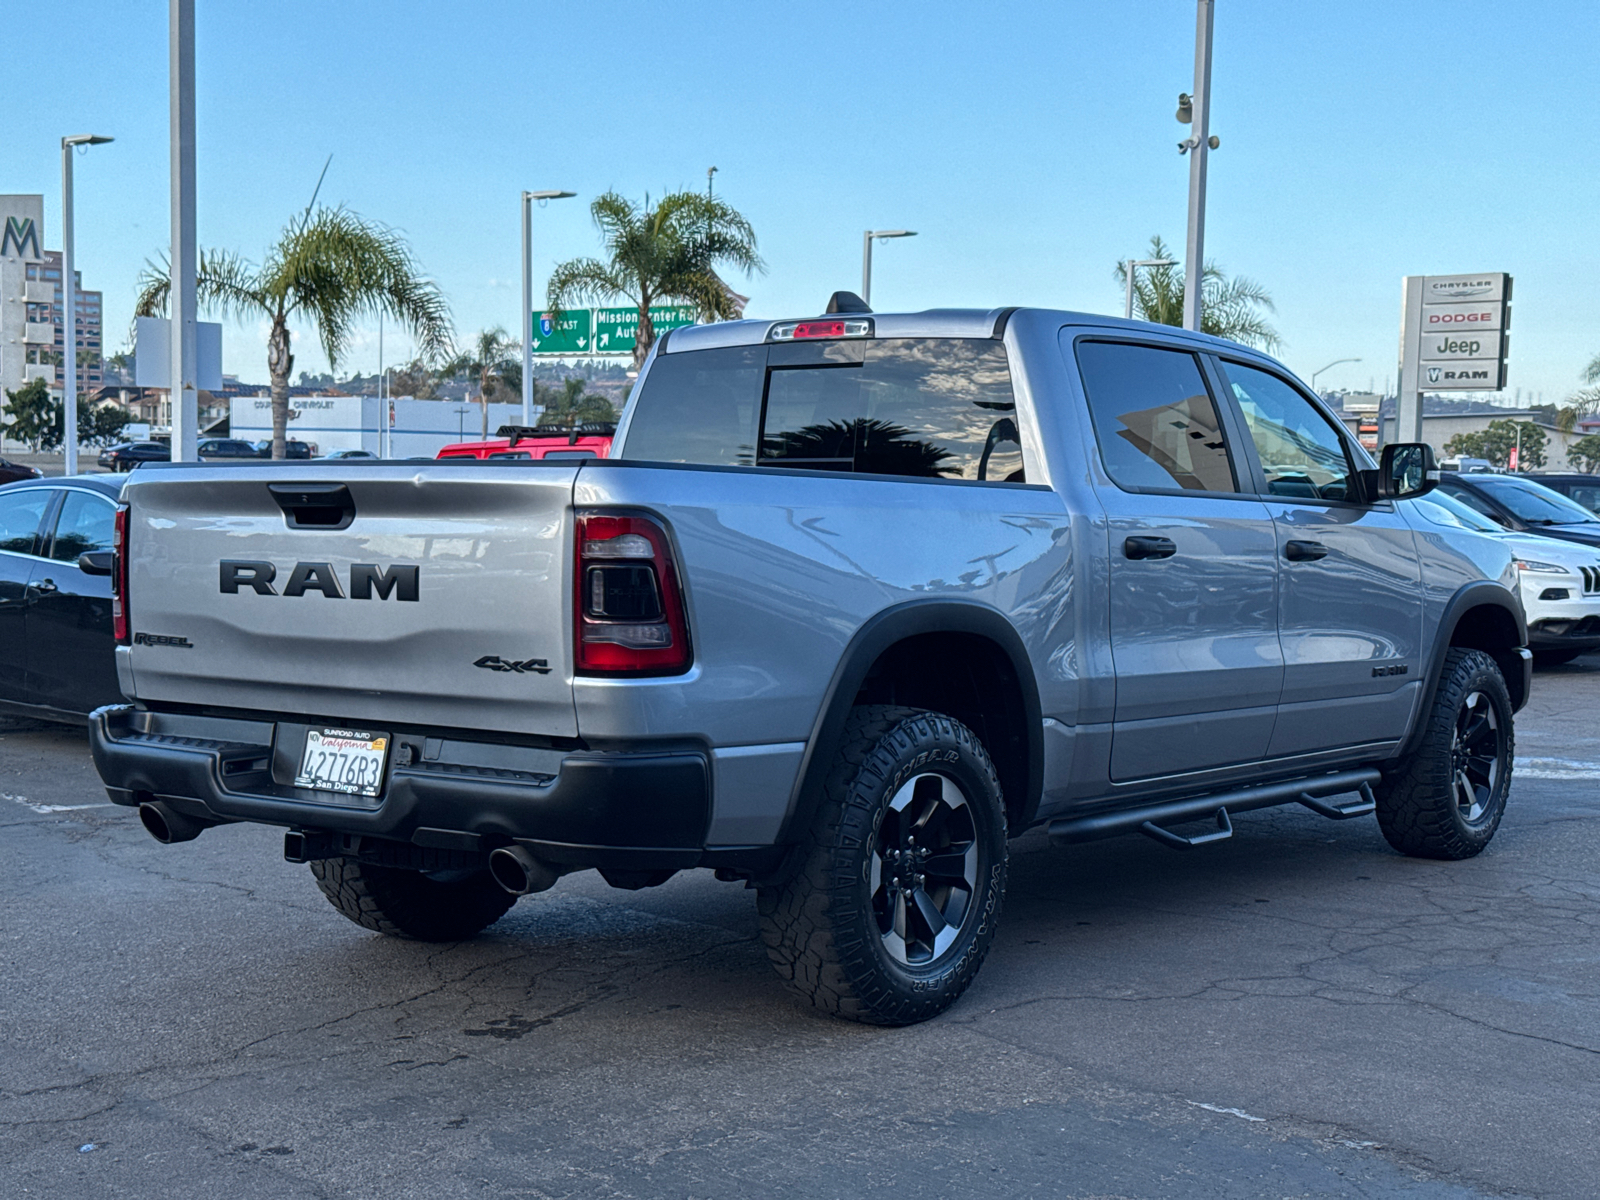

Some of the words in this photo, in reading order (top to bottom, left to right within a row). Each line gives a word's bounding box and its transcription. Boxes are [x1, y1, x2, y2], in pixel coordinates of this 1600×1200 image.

[1432, 281, 1492, 289] CHRYSLER
[598, 311, 638, 323] Mission
[1429, 313, 1492, 323] DODGE
[545, 321, 549, 331] 8
[616, 326, 635, 338] Aut
[1437, 337, 1480, 356] Jeep
[1444, 370, 1488, 379] RAM
[293, 401, 335, 409] CHEVROLET
[219, 558, 420, 602] RAM
[134, 631, 194, 648] REBEL
[472, 655, 553, 675] 4x4
[1371, 664, 1409, 677] RAM
[324, 729, 353, 737] SUNROAD
[321, 736, 371, 752] California
[303, 750, 379, 786] 42776R3
[316, 780, 332, 788] San
[335, 782, 358, 793] Diego
[912, 863, 1001, 992] WRANGLER
